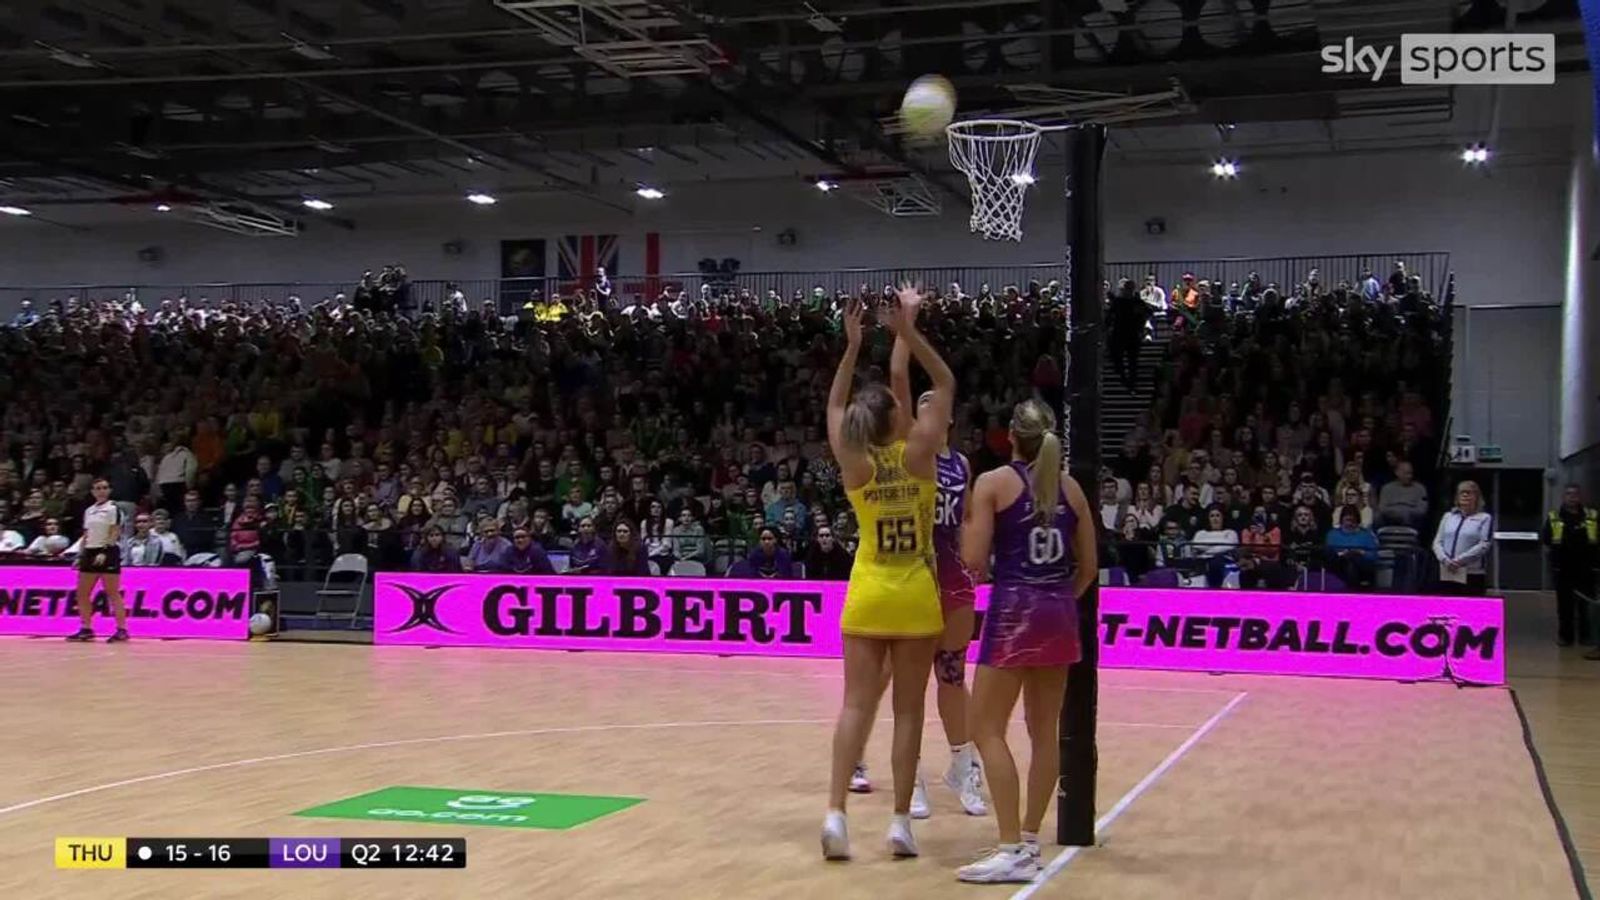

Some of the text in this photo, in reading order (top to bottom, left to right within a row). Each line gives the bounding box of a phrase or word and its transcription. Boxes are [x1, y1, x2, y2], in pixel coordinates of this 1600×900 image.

[934, 493, 958, 526] GK
[876, 517, 917, 554] GS
[1029, 526, 1064, 564] GD
[482, 584, 822, 644] GILBERT
